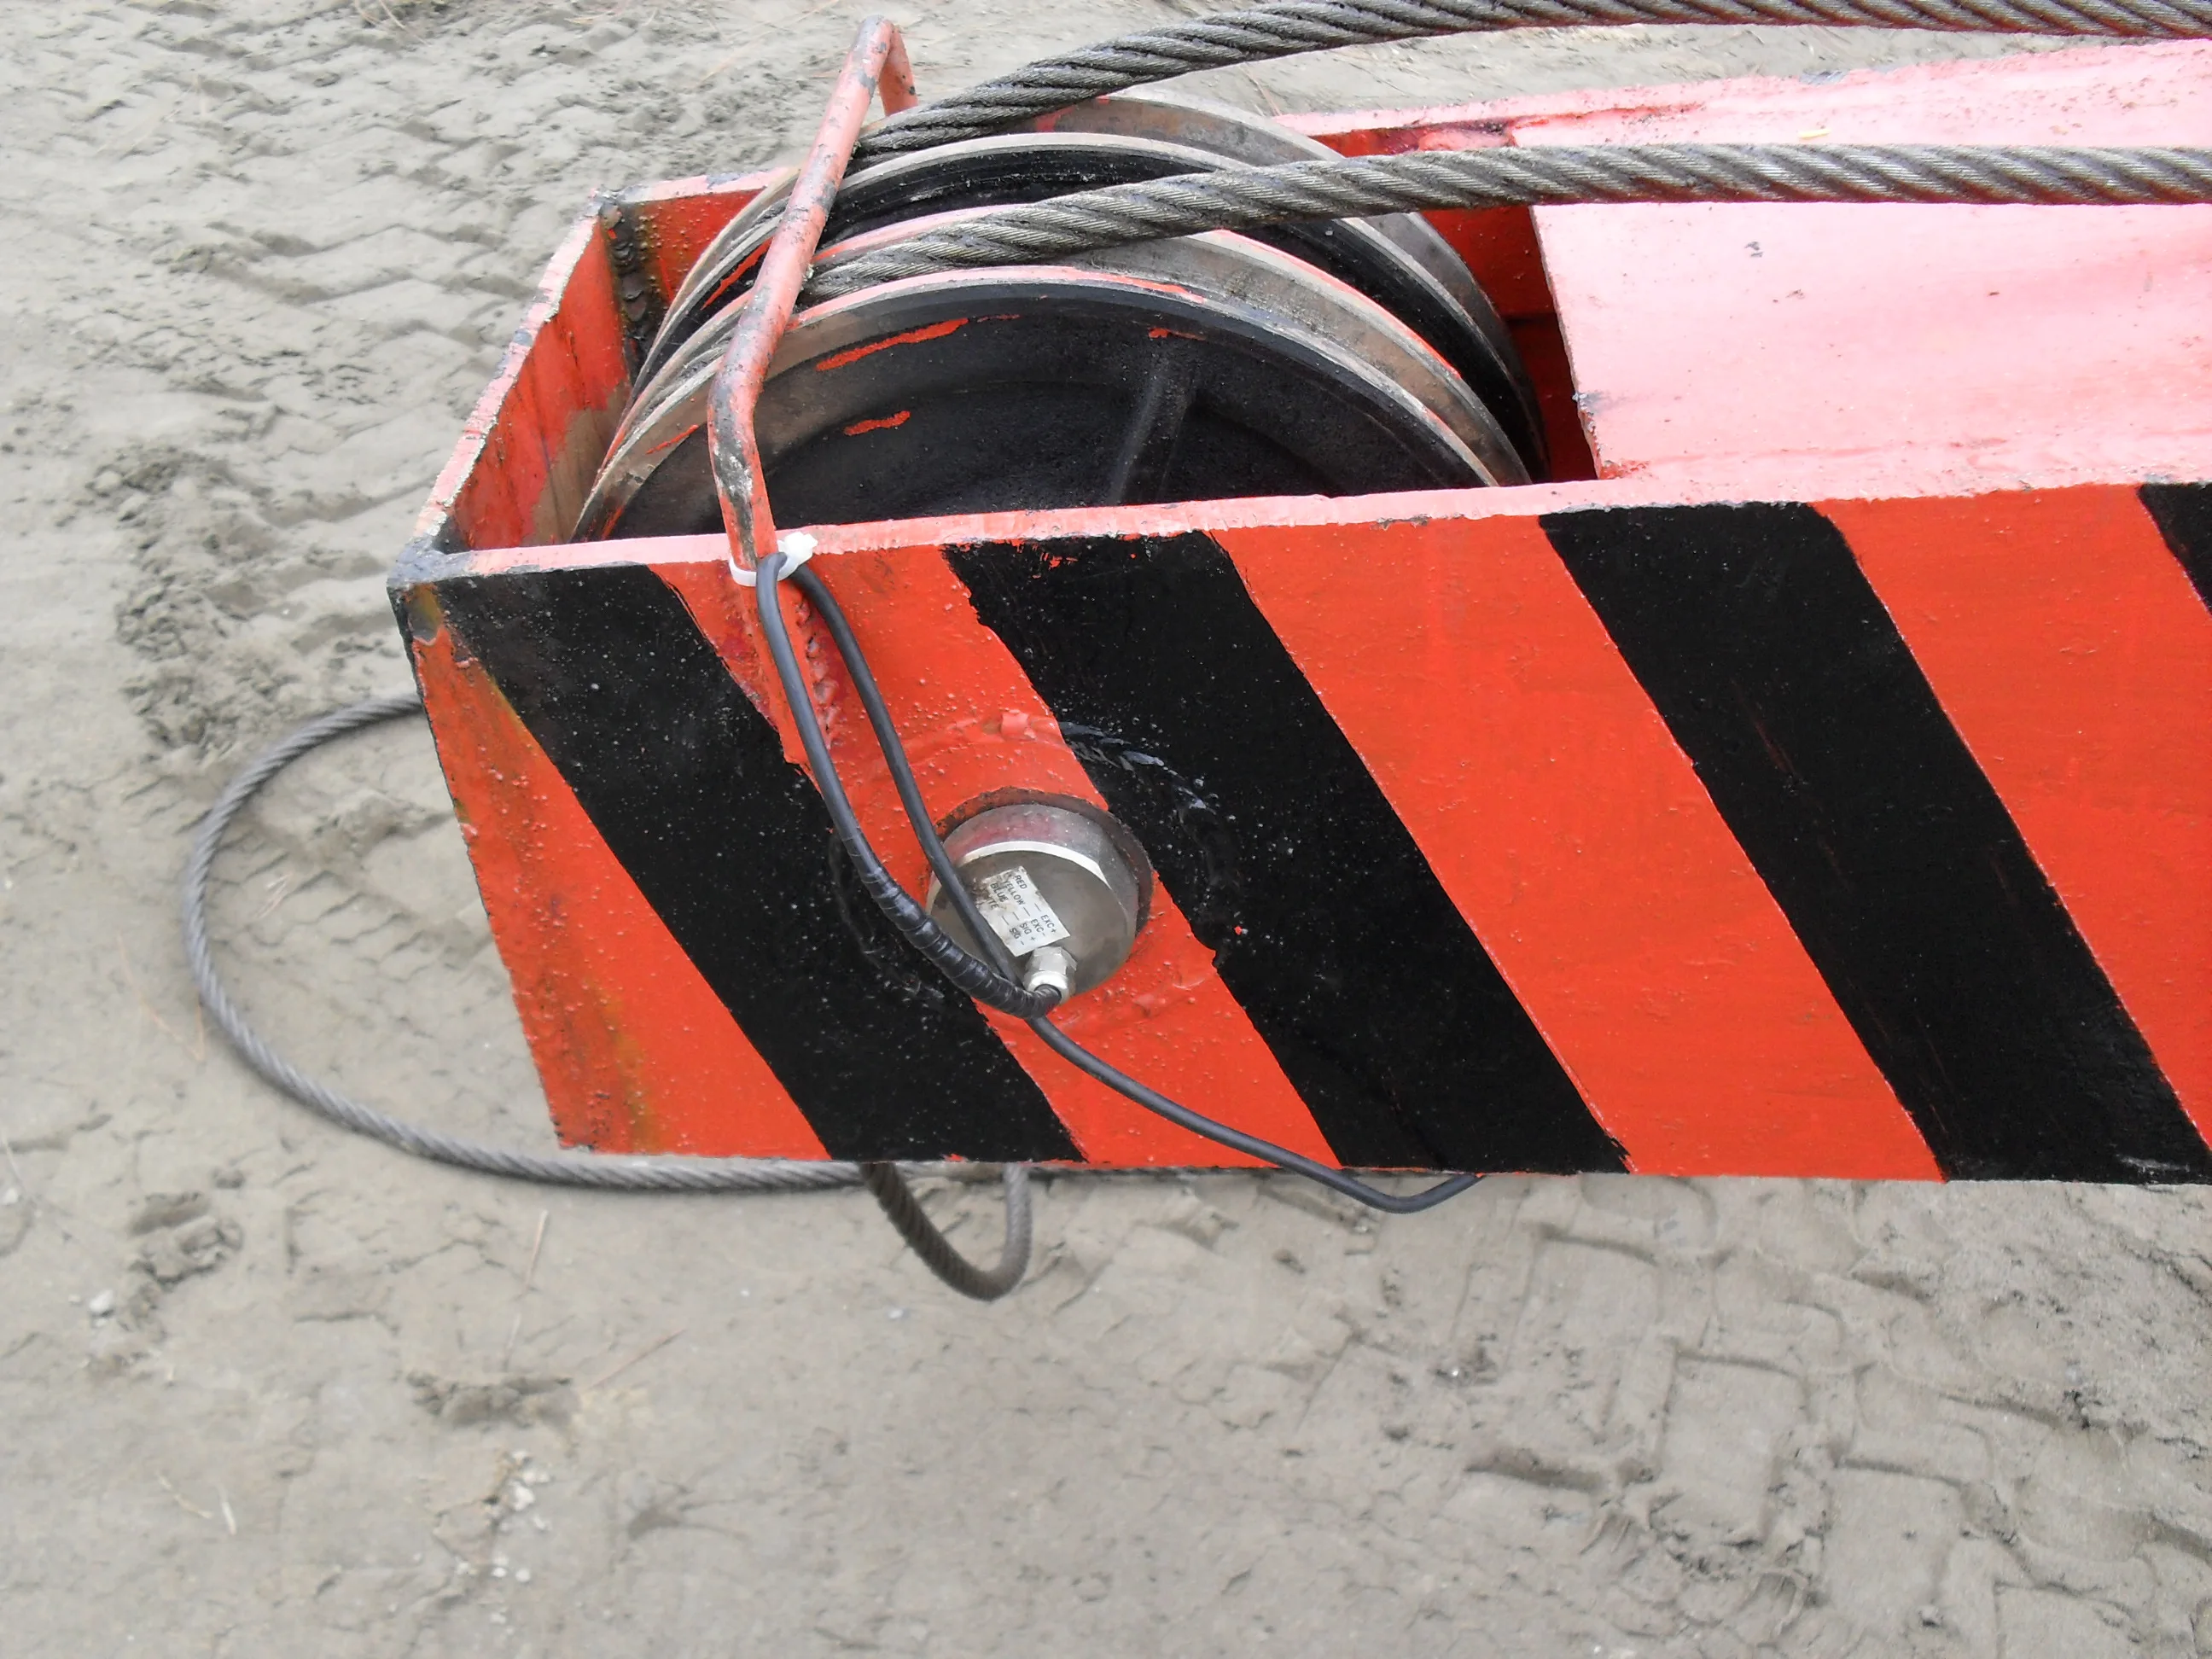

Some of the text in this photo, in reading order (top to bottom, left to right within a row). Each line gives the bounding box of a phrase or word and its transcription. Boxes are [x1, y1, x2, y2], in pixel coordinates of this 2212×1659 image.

[990, 882, 1009, 902] BLUE
[1004, 880, 1025, 905] YELLOW
[1014, 875, 1027, 889] RED
[1041, 915, 1057, 933] EXC+
